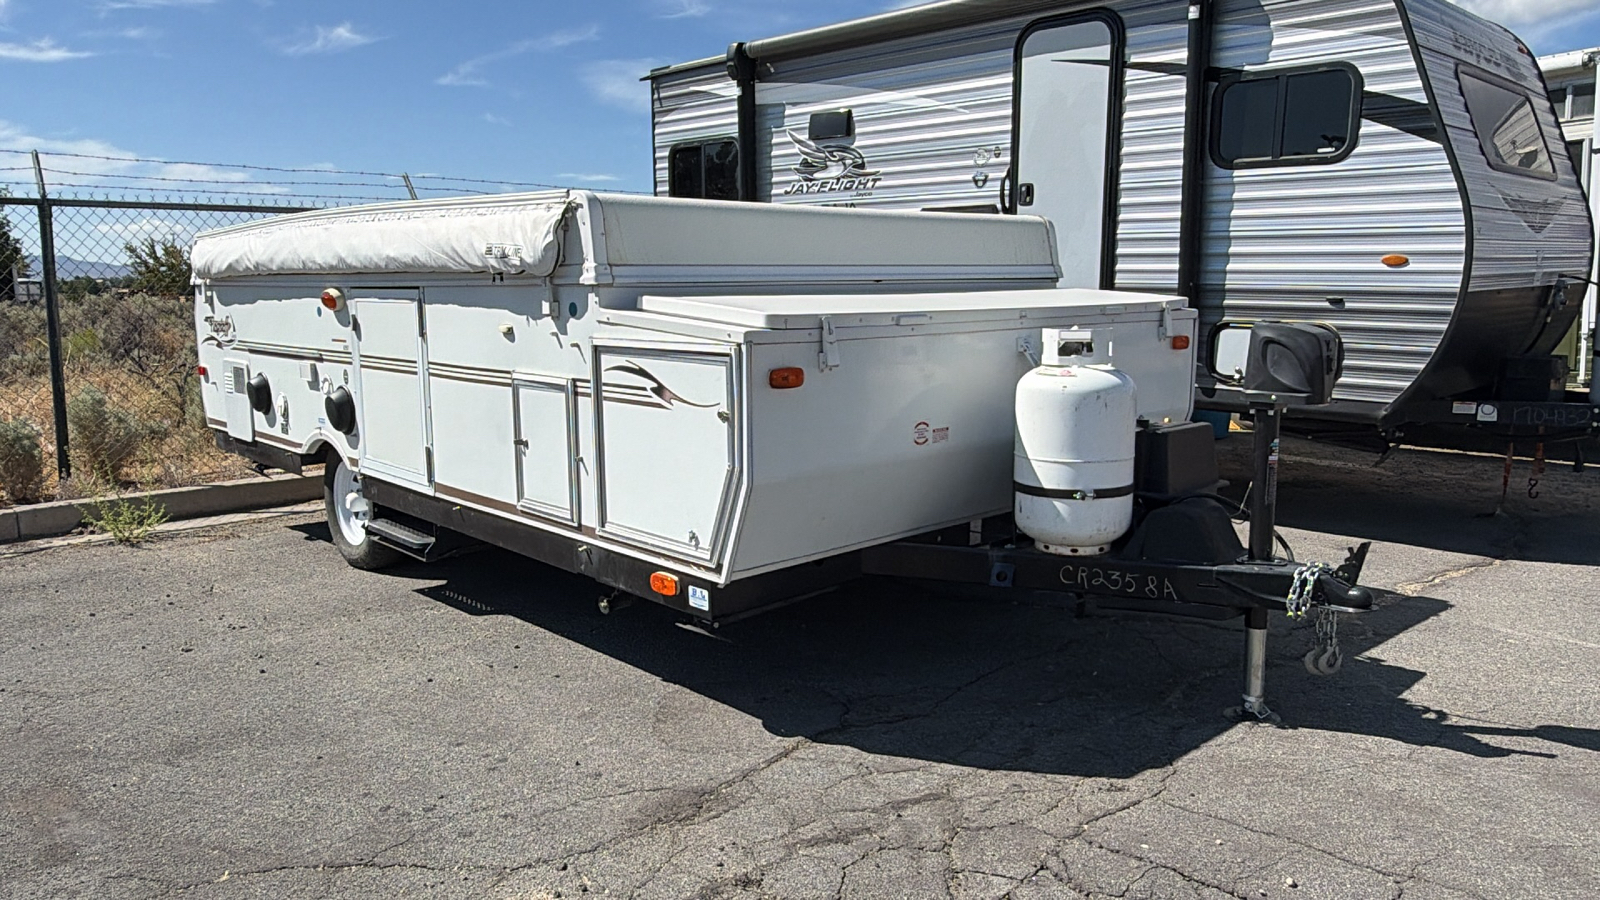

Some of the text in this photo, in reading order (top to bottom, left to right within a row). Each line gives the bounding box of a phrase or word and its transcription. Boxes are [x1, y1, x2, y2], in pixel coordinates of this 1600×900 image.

[784, 177, 882, 195] JAY FLIGHT
[1059, 565, 1177, 600] CR2358A
